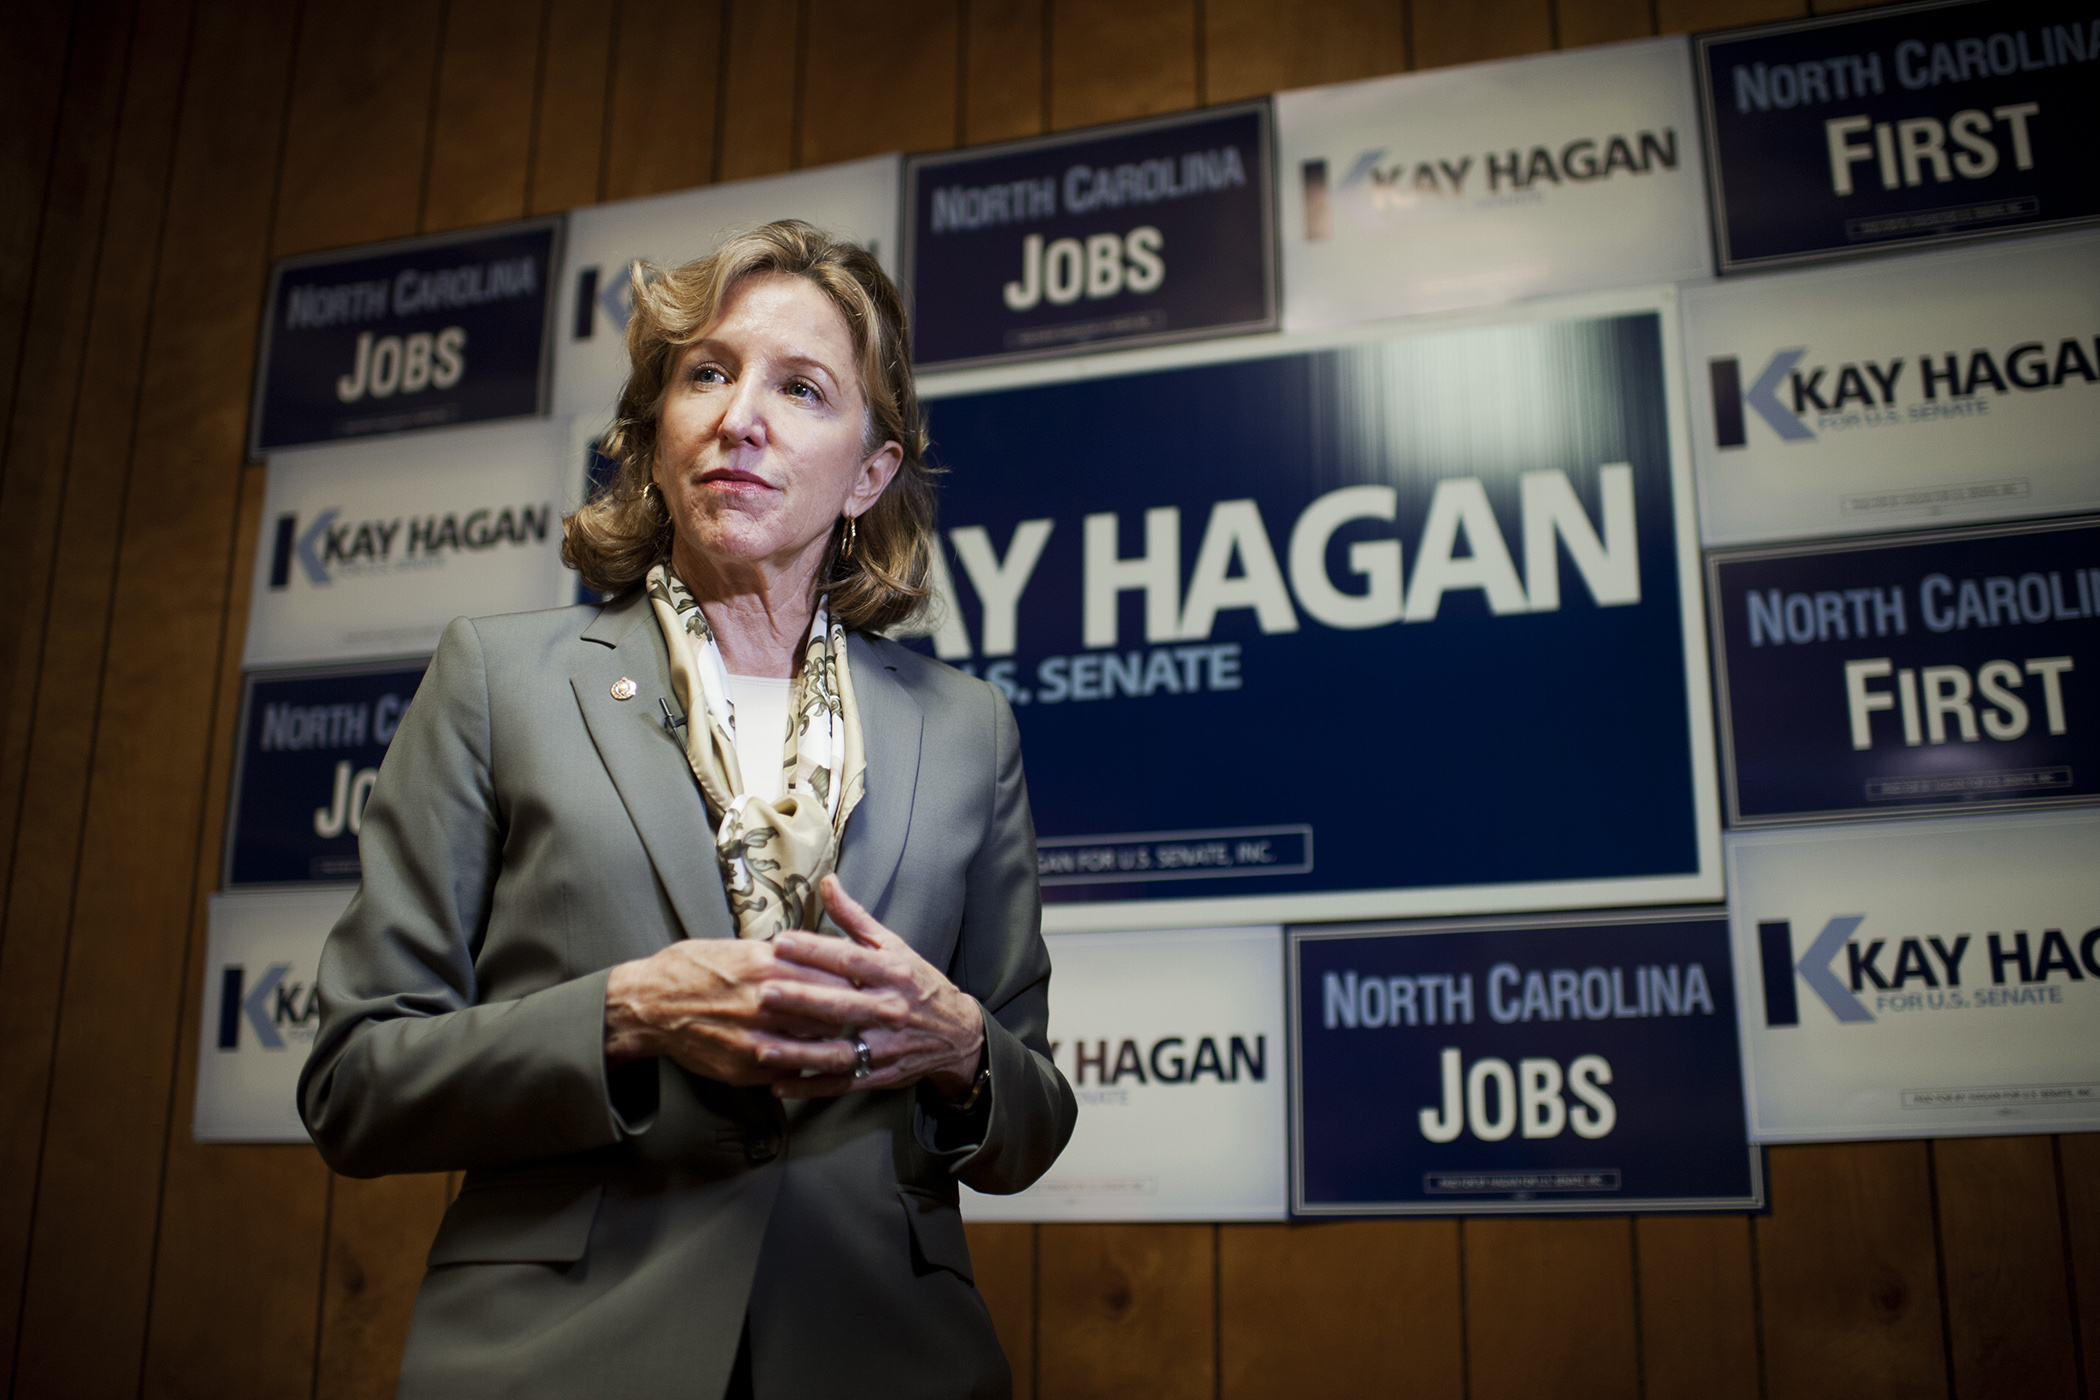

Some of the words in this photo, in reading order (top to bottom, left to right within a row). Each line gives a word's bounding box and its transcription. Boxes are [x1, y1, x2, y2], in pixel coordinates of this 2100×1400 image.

[1732, 51, 1885, 114] NORTH
[1488, 129, 1676, 190] HAGAN
[1825, 101, 2040, 197] FIRST
[930, 177, 1057, 234] NORTH
[1063, 145, 1247, 213] CAROLINA
[288, 284, 388, 329] NORTH
[393, 258, 536, 317] CAROLINA
[1003, 224, 1166, 311] JOBS
[336, 325, 468, 403] JOBS
[1790, 357, 1906, 415] KAY
[1919, 334, 2100, 403] HAGA
[323, 518, 400, 564] KAY
[406, 502, 549, 556] HAGAN
[1082, 462, 1642, 650] HAGAN
[1746, 586, 1907, 648] NORTH
[1037, 643, 1243, 704] SENATE
[1844, 655, 2074, 751] FIRST
[260, 702, 369, 751] NORTH
[1077, 847, 1116, 873] FOR
[1323, 969, 1475, 1030] NORTH
[1487, 961, 1715, 1024] CAROLINA
[1847, 932, 1971, 993] KAY
[1876, 992, 1923, 1013] FOR
[1927, 989, 1970, 1011] U.S.
[1973, 985, 2063, 1010] SENATE
[1074, 1034, 1268, 1086] HAGAN
[1418, 1046, 1618, 1143] JOBS
